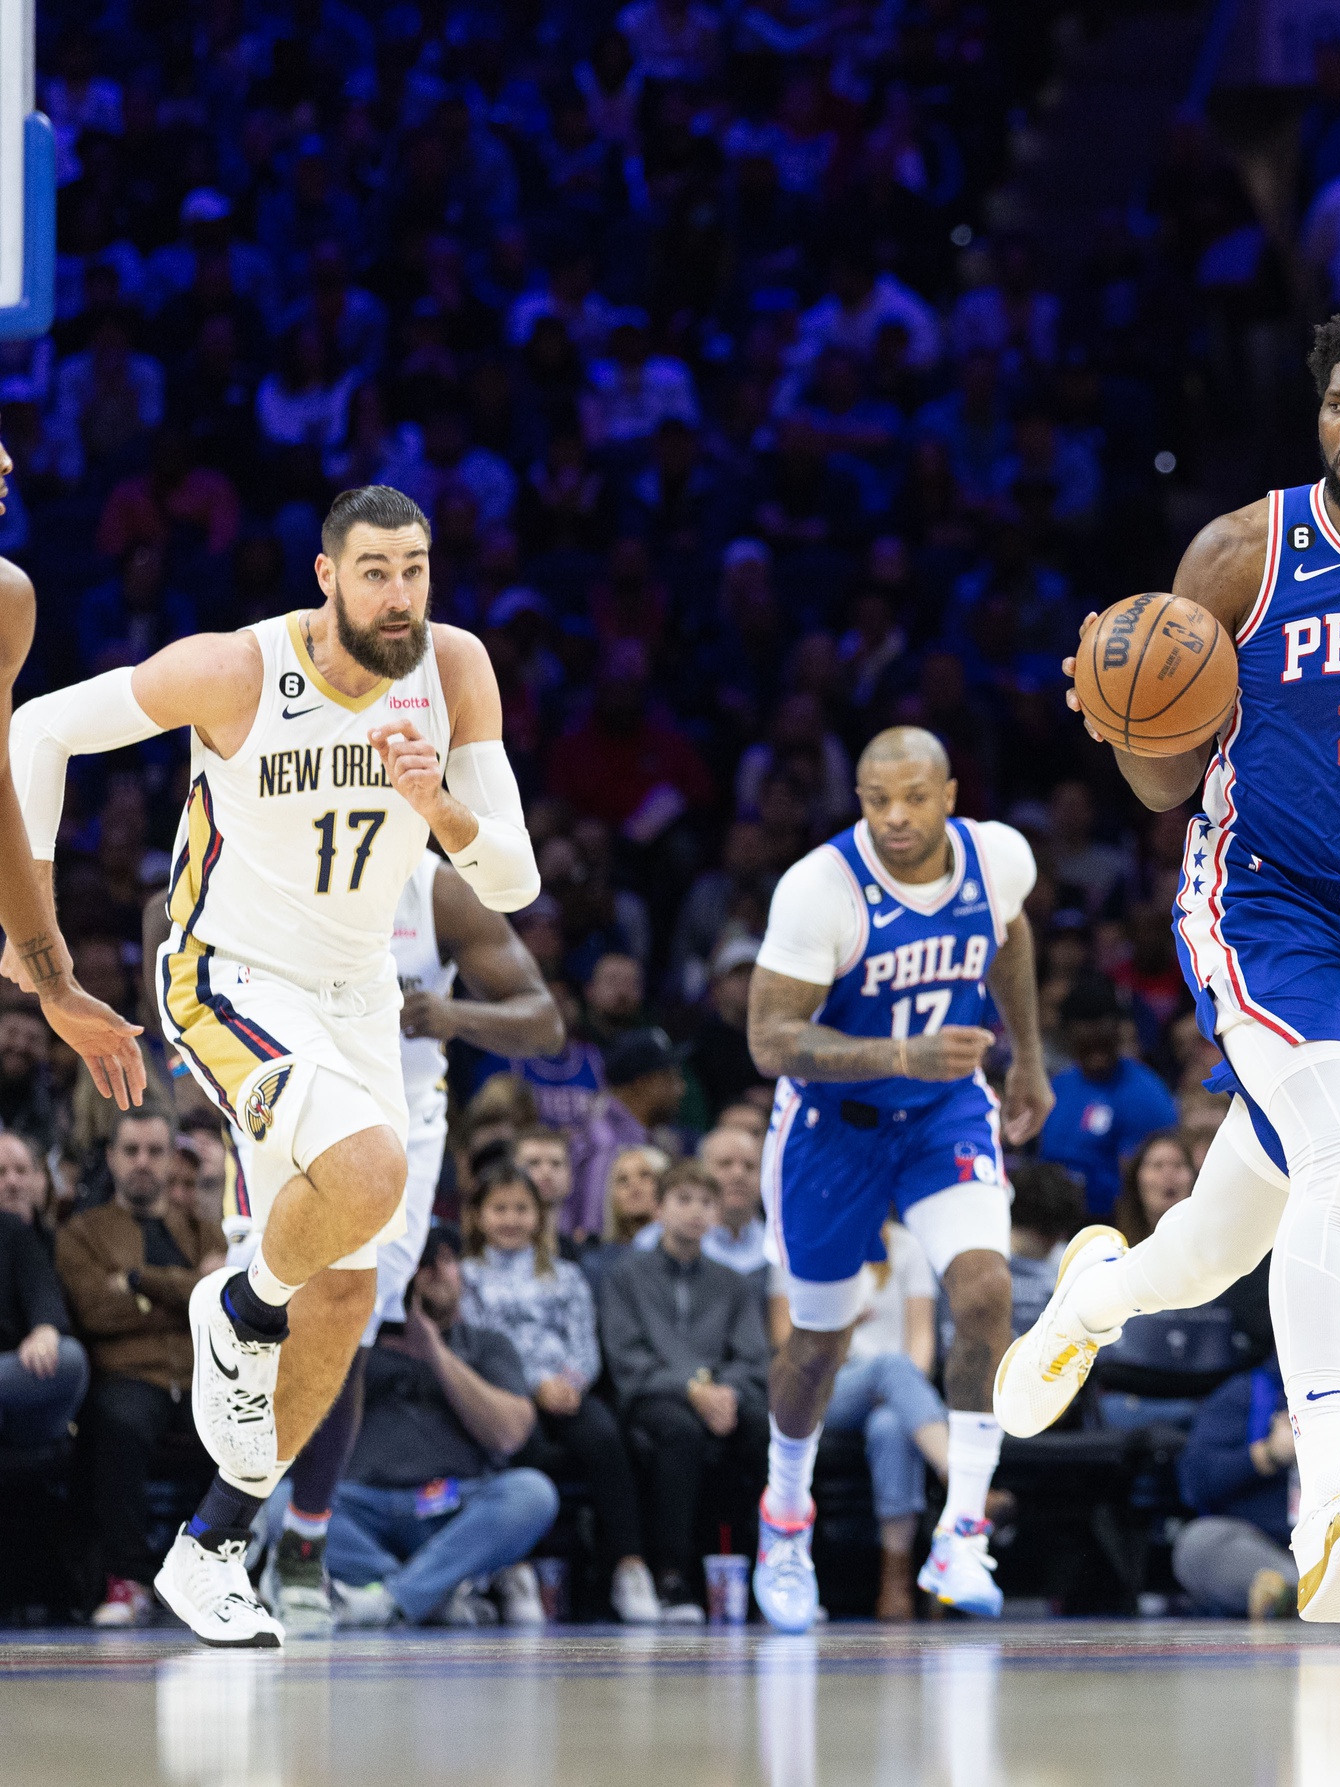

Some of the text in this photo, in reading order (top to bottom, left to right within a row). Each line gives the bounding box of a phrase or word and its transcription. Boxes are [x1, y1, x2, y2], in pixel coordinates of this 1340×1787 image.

[1294, 527, 1309, 549] 6
[284, 675, 300, 698] 6
[389, 696, 430, 709] ibotta
[260, 747, 323, 798] NEW
[312, 808, 388, 895] 17
[860, 934, 989, 997] PHILA
[891, 988, 953, 1040] 17
